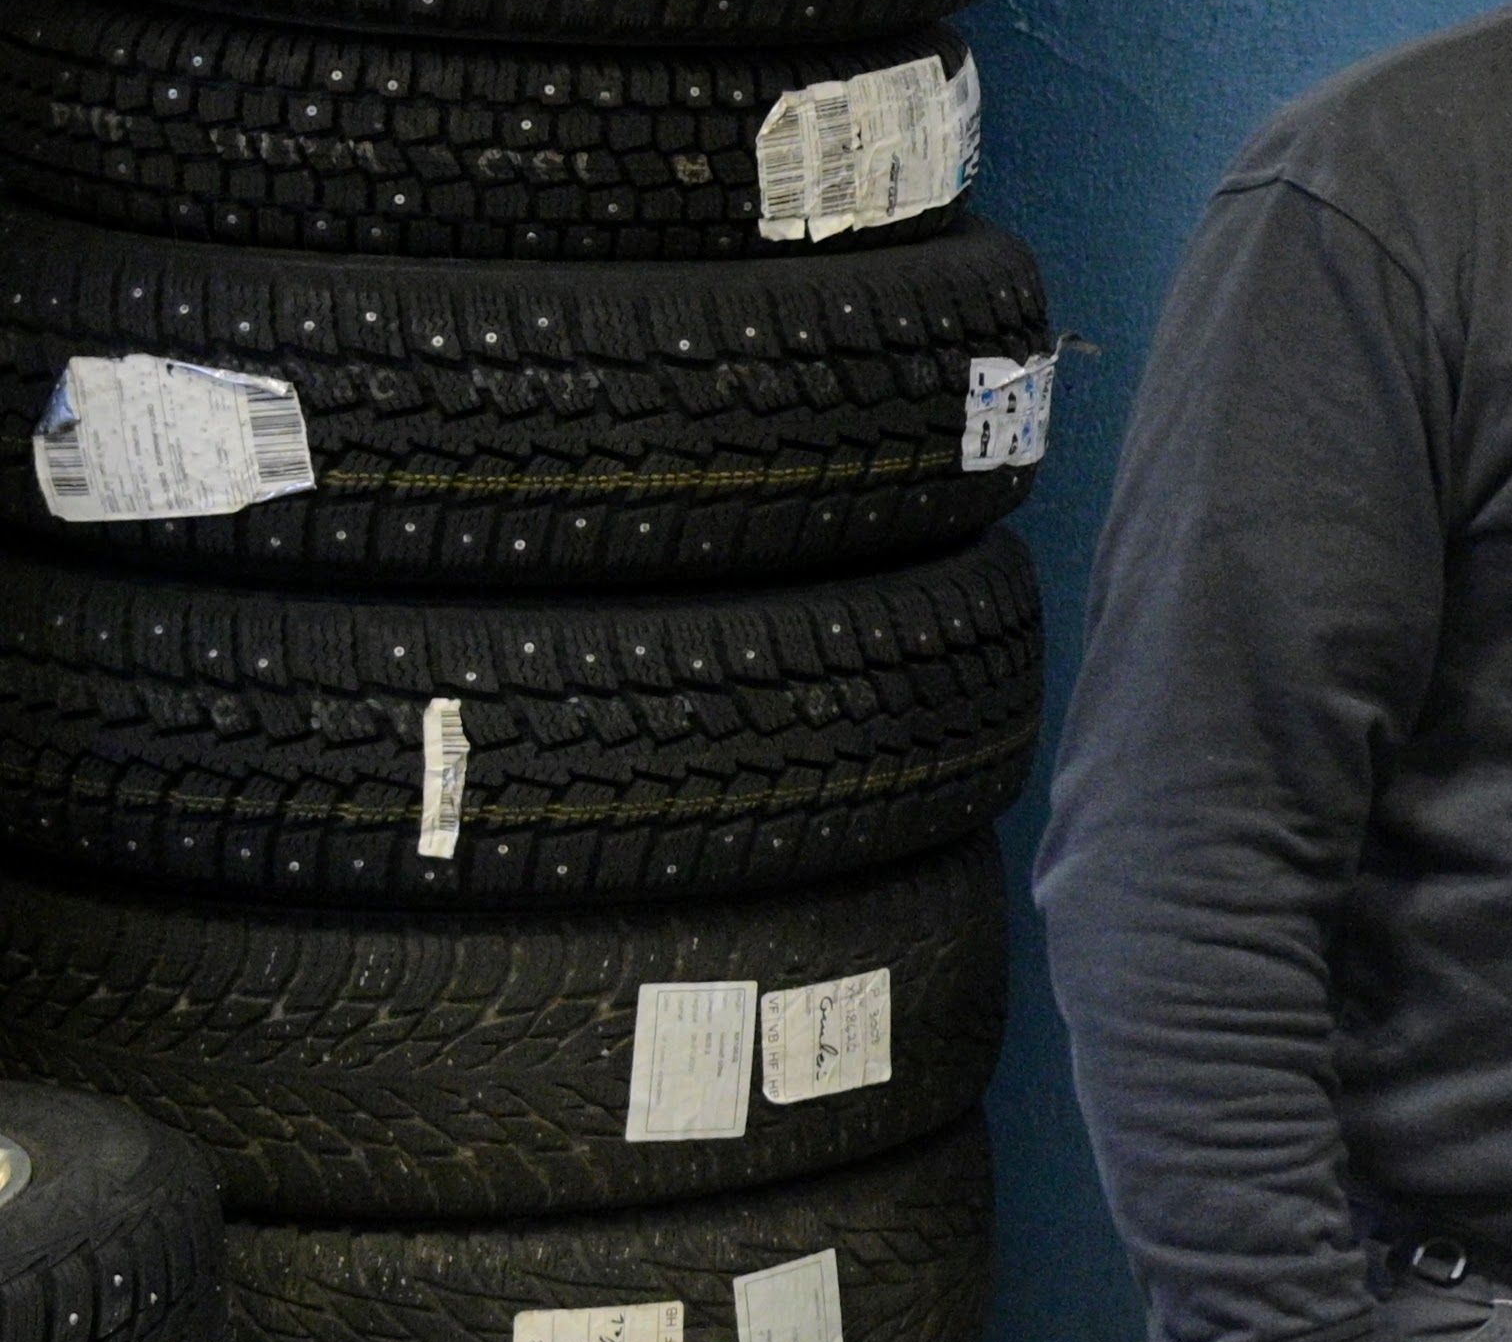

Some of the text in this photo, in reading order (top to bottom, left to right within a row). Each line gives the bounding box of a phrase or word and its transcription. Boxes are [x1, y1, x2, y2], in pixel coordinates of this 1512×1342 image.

[768, 996, 777, 1014] VF
[768, 1024, 778, 1043] VB
[768, 1052, 777, 1069] HF
[666, 1306, 677, 1326] HB
